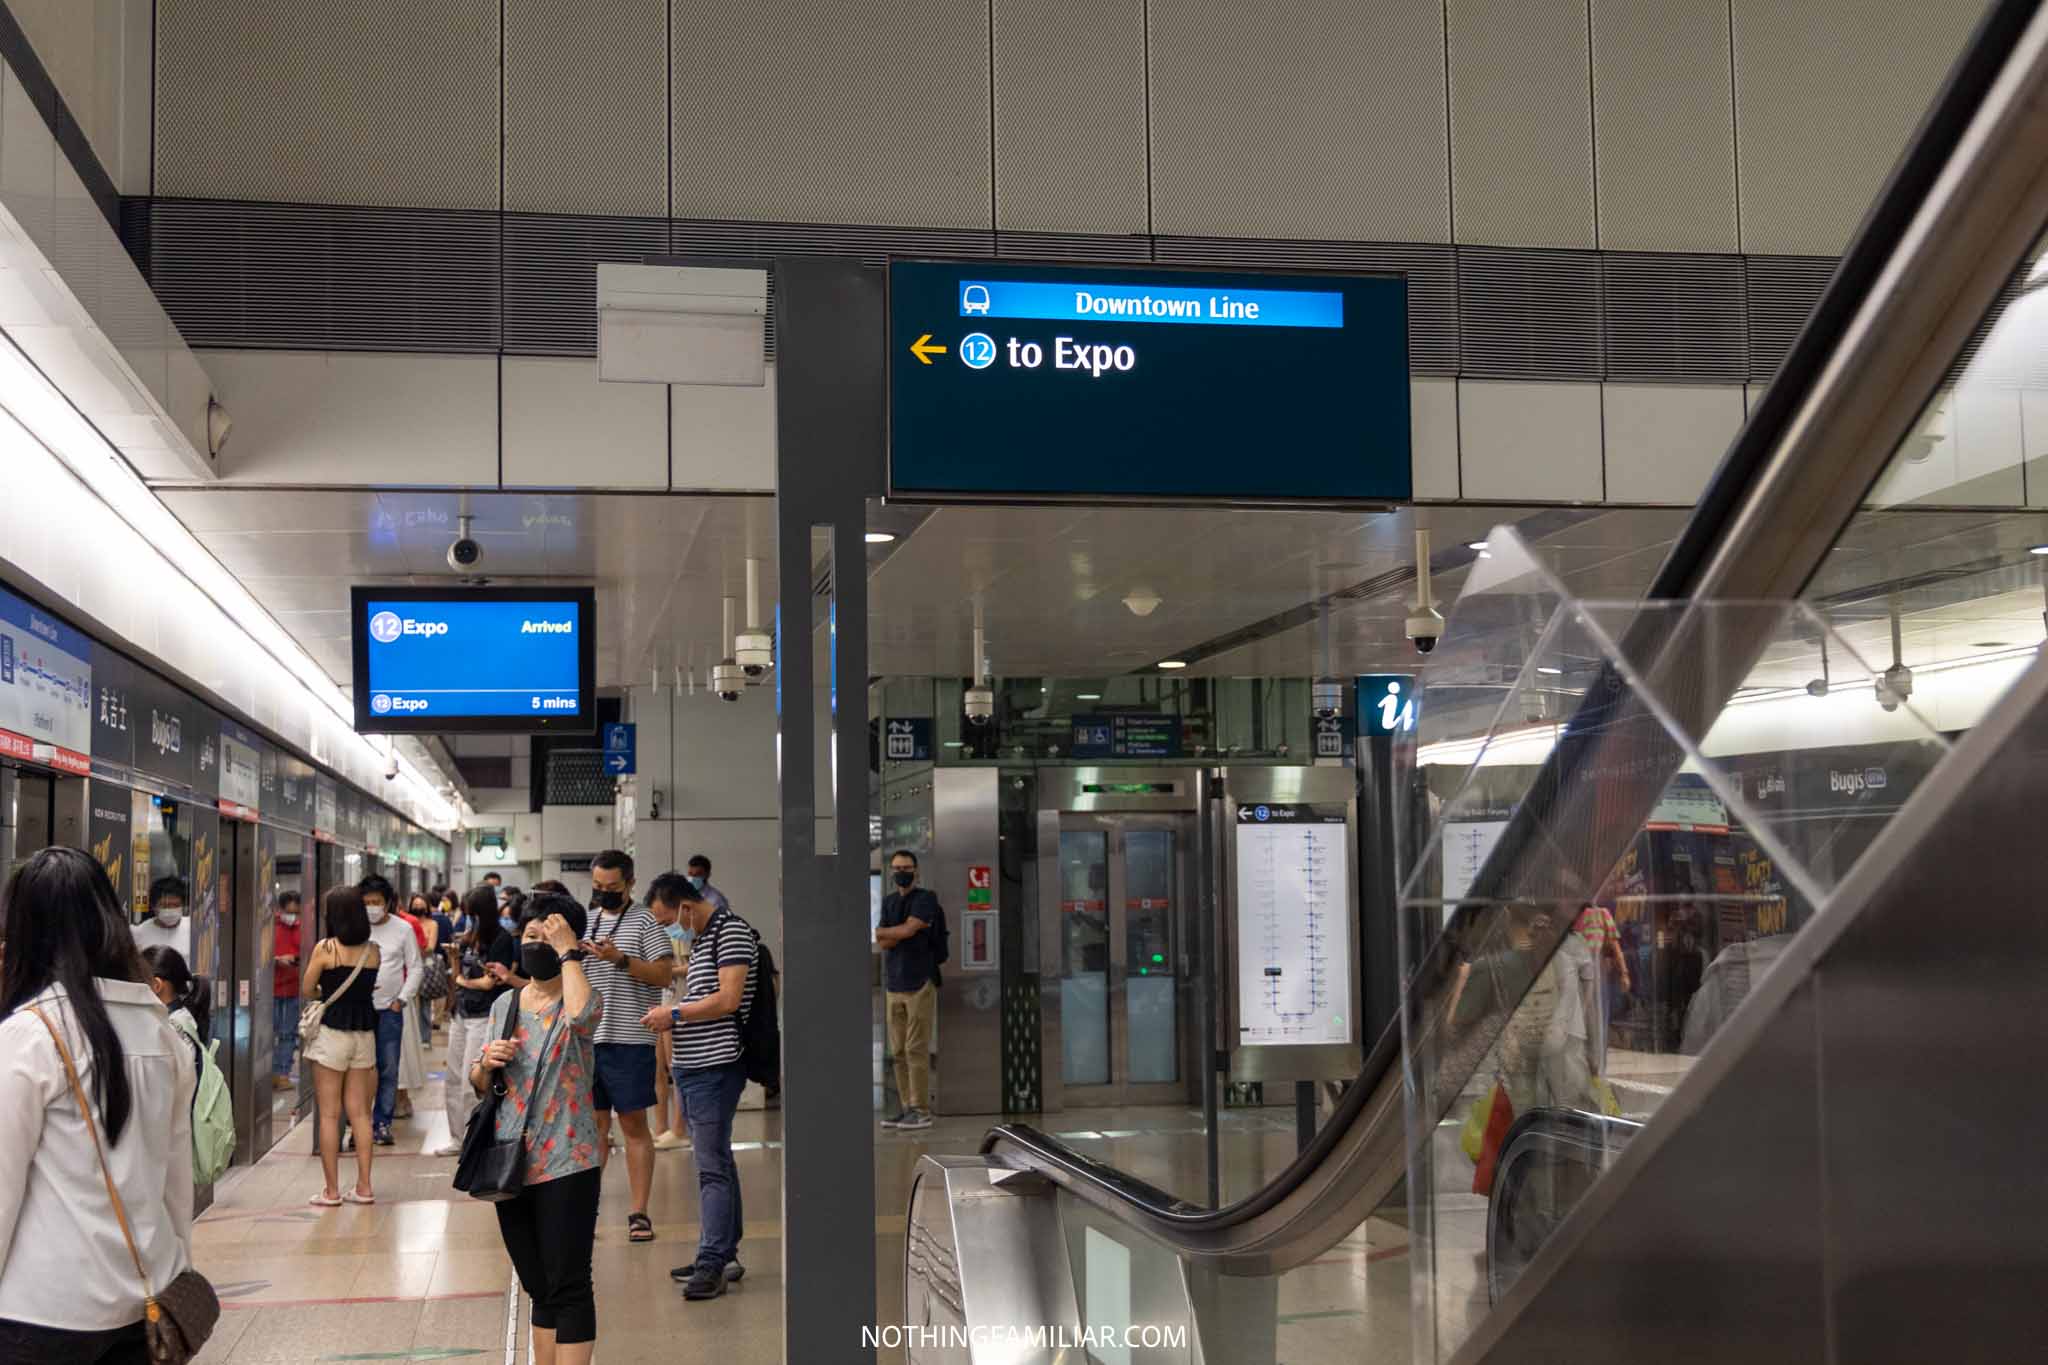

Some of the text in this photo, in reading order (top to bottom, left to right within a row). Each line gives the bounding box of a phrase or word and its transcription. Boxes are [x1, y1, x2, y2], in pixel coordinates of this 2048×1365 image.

[1075, 291, 1259, 319] Downtown Line
[964, 336, 1135, 378] 12 to Expo
[373, 618, 448, 638] 12 Expo
[521, 620, 573, 634] Arrived
[392, 698, 428, 711] Expo
[531, 697, 577, 709] 5 mins
[1830, 768, 1865, 795] Bugis
